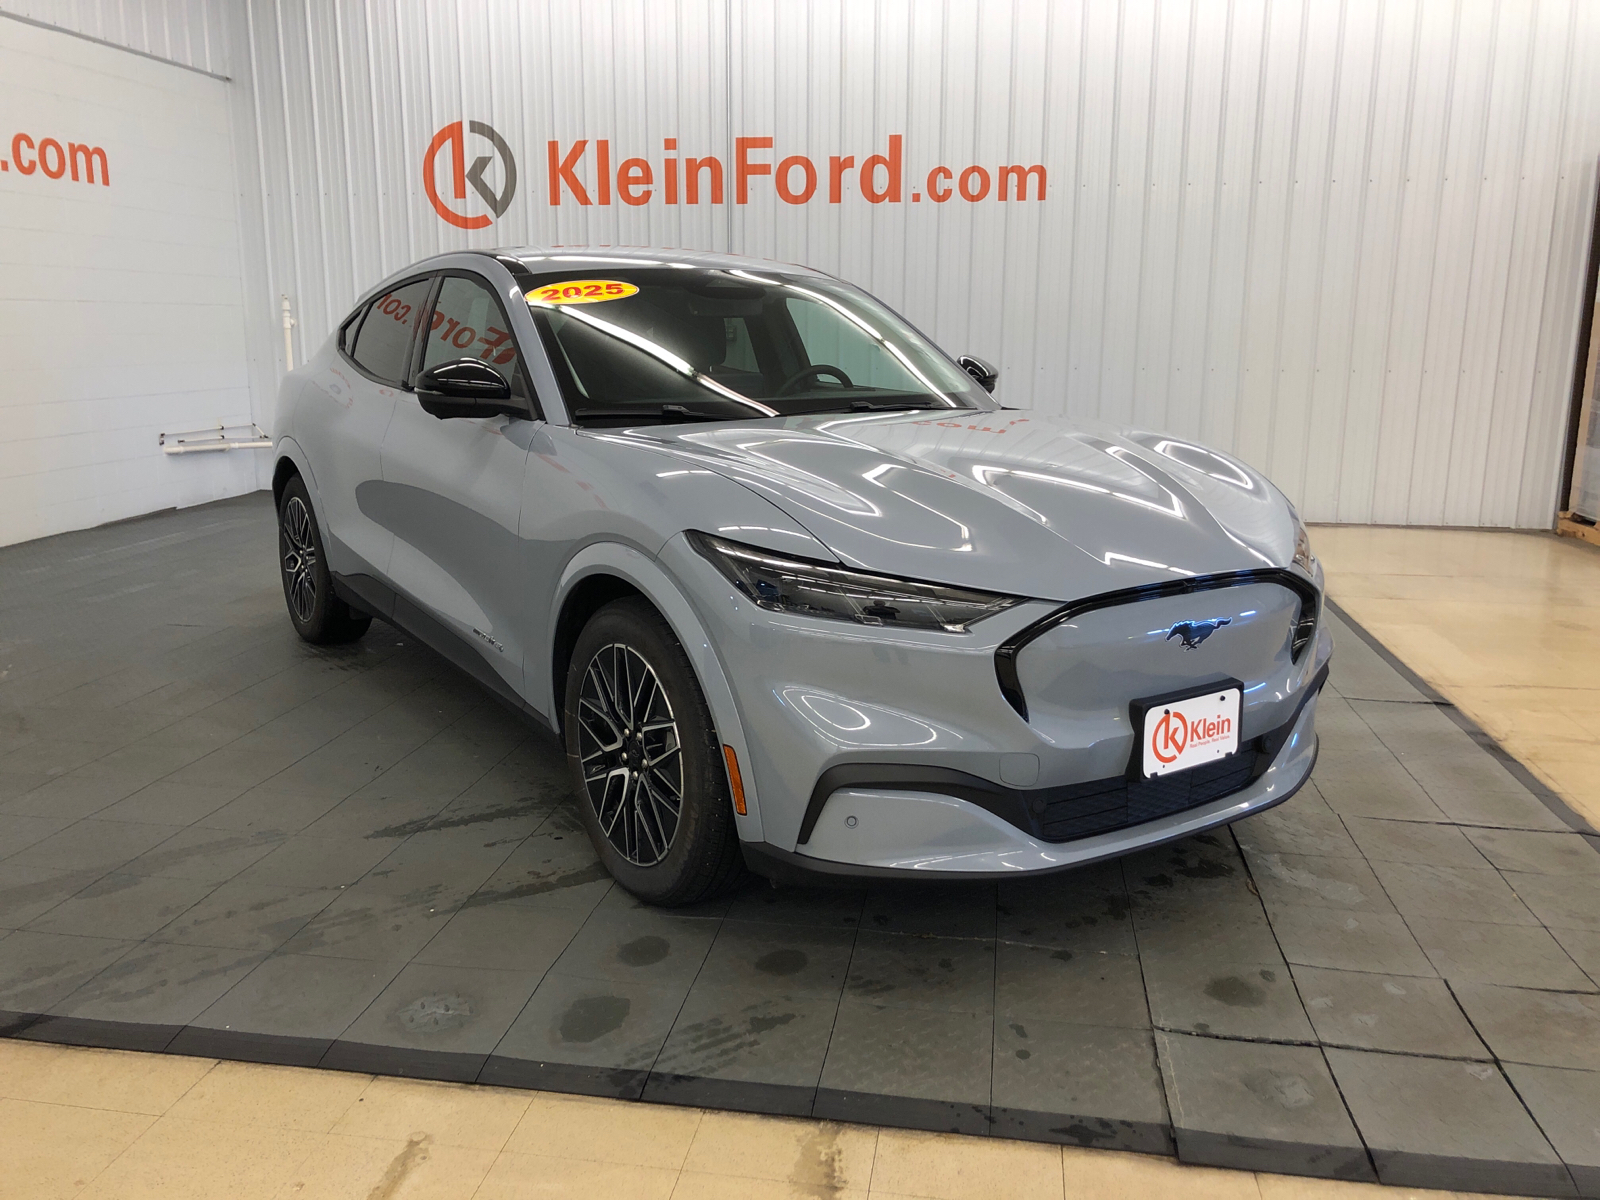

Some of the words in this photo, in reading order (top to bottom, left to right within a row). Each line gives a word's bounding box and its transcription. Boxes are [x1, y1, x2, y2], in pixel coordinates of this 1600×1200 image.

[0, 132, 110, 187] .com
[541, 283, 625, 301] 2025
[1189, 714, 1231, 742] Klein
